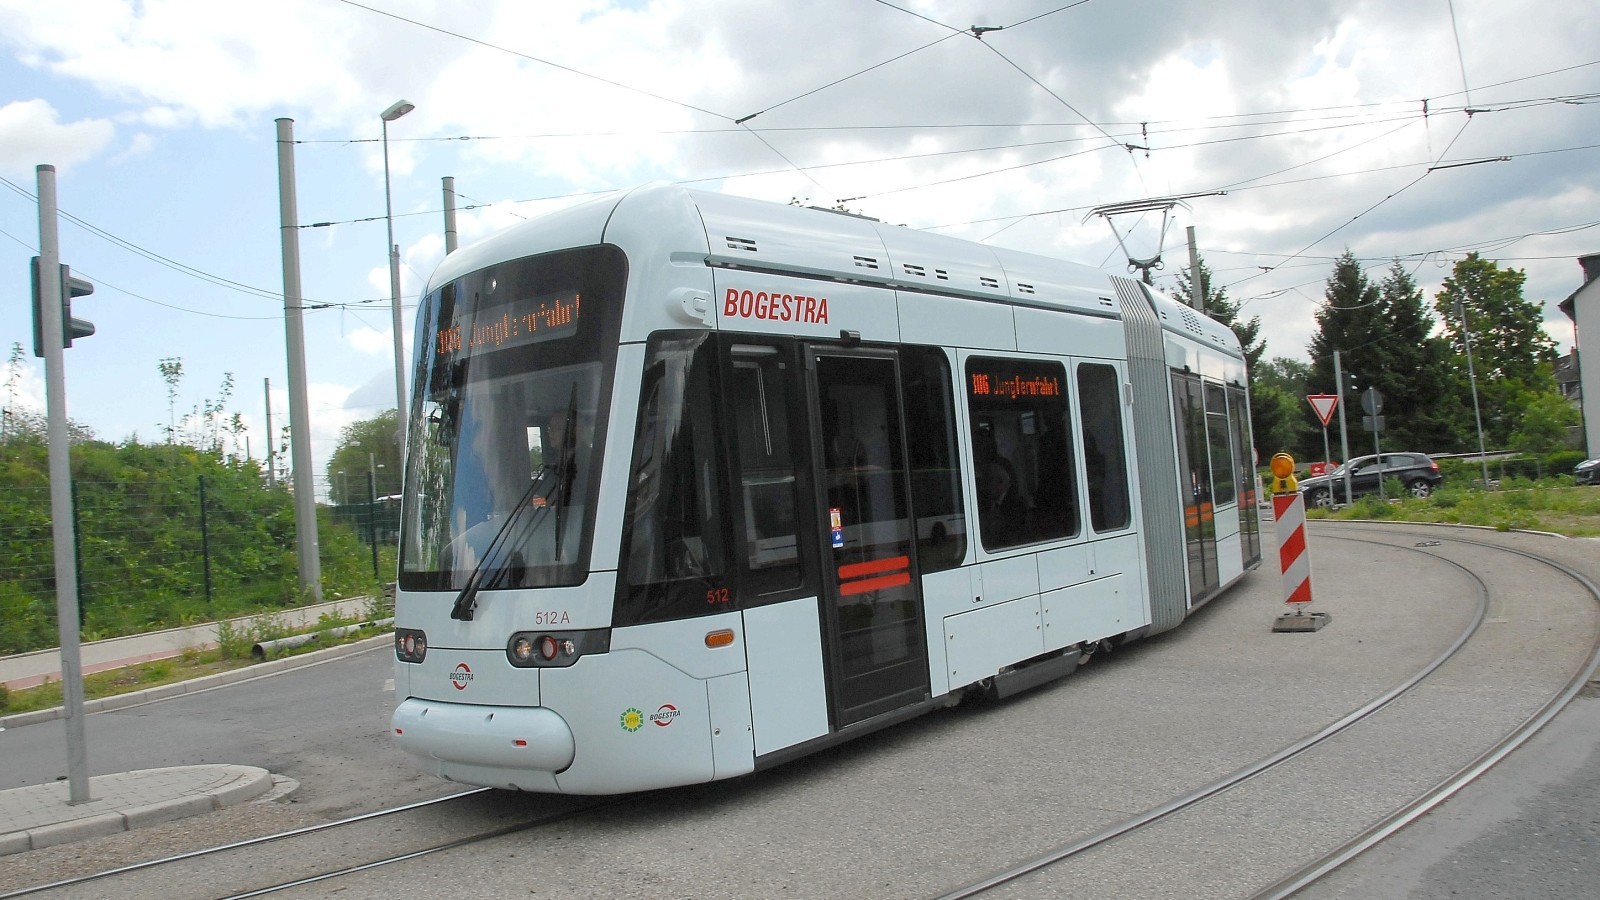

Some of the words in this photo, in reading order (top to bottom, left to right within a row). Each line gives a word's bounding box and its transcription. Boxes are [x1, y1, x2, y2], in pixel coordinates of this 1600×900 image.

[724, 288, 828, 325] BOGESTRA
[706, 588, 729, 604] 512
[535, 611, 558, 625] 512
[560, 610, 570, 624] A
[449, 672, 474, 682] BOGESTRA
[649, 710, 681, 721] BOGESTRA
